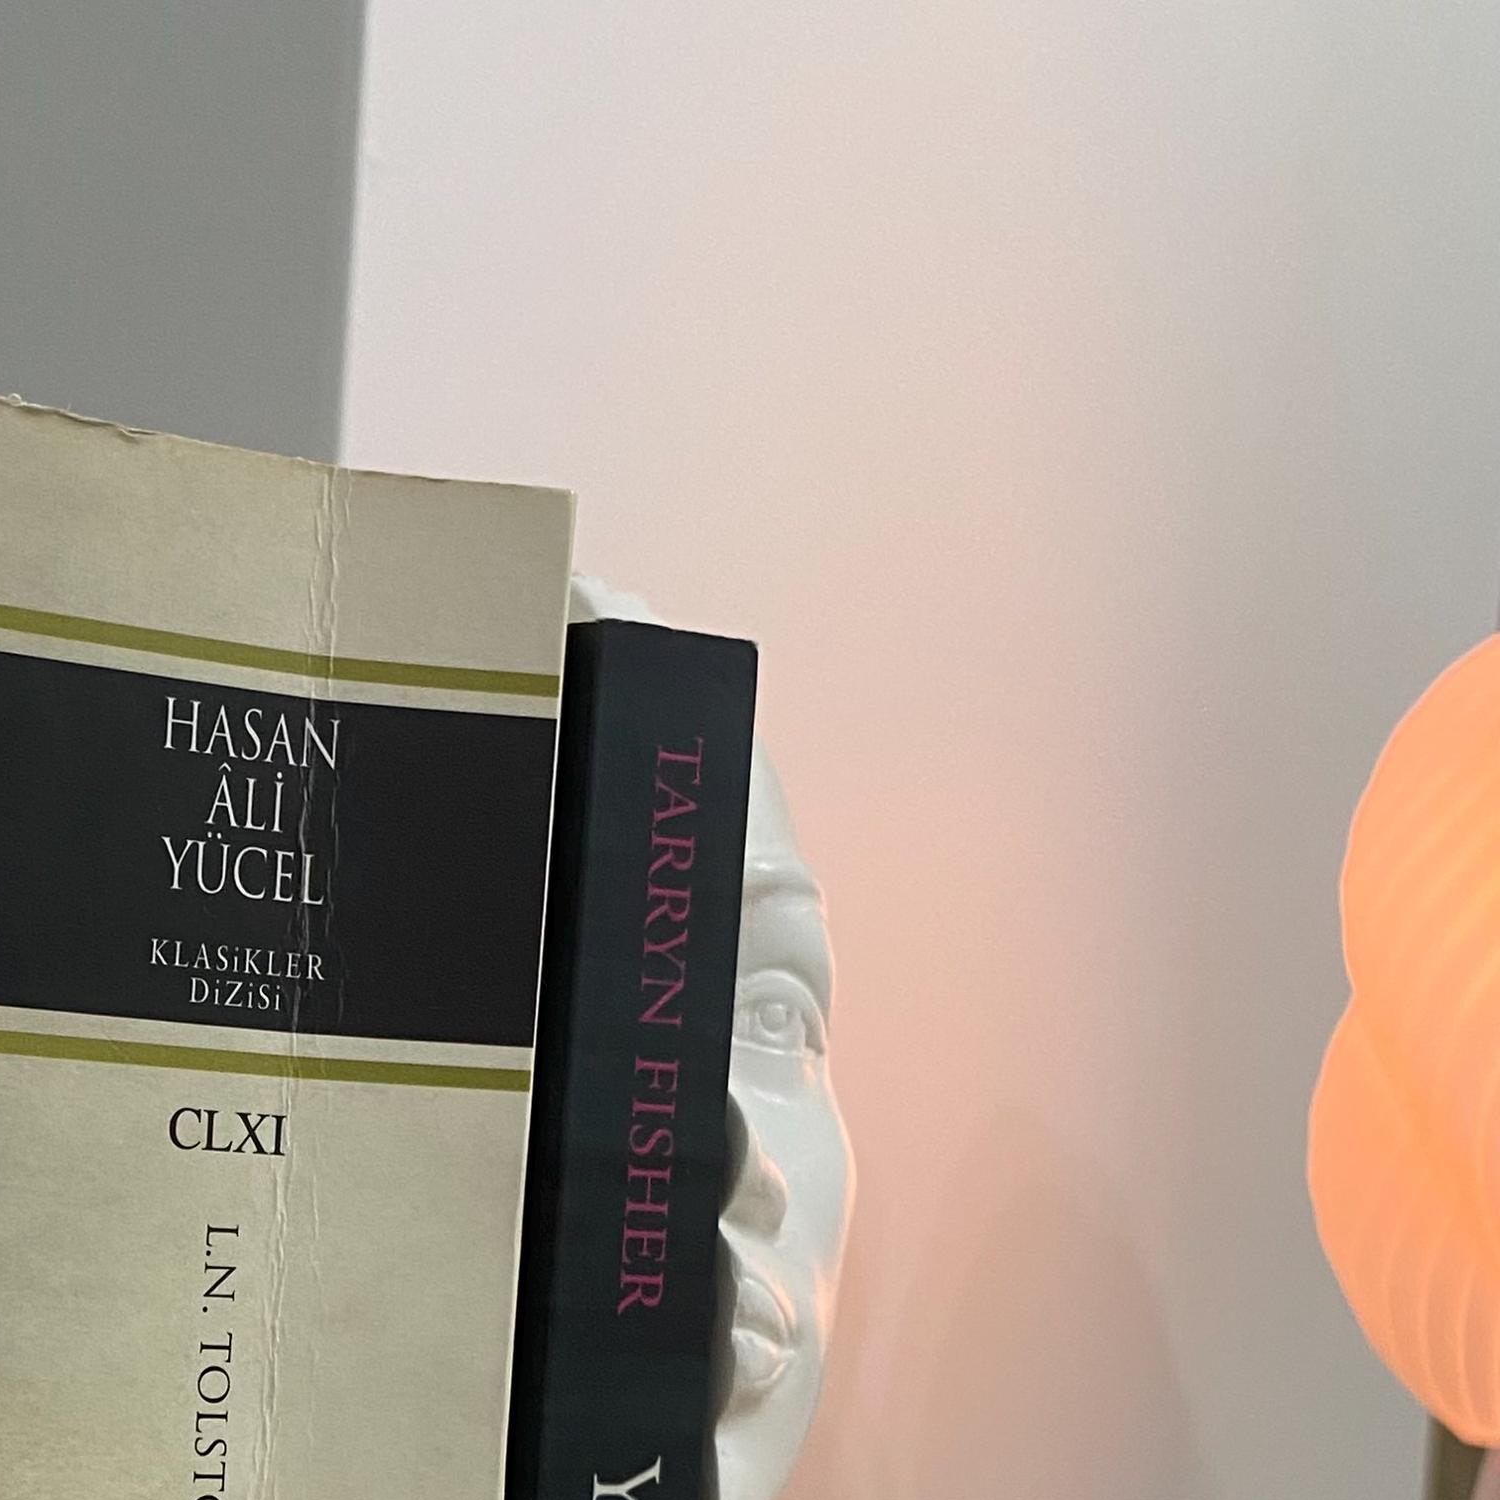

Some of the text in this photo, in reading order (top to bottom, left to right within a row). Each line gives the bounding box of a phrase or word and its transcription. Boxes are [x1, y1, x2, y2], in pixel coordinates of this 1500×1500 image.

[163, 697, 341, 771] HASAN
[205, 762, 286, 834] ÂLİ
[160, 831, 324, 906] YÜCEL
[617, 736, 704, 1315] TARRYN FISHER
[167, 1107, 289, 1157] CLXI
[201, 1222, 240, 1315] L.N.
